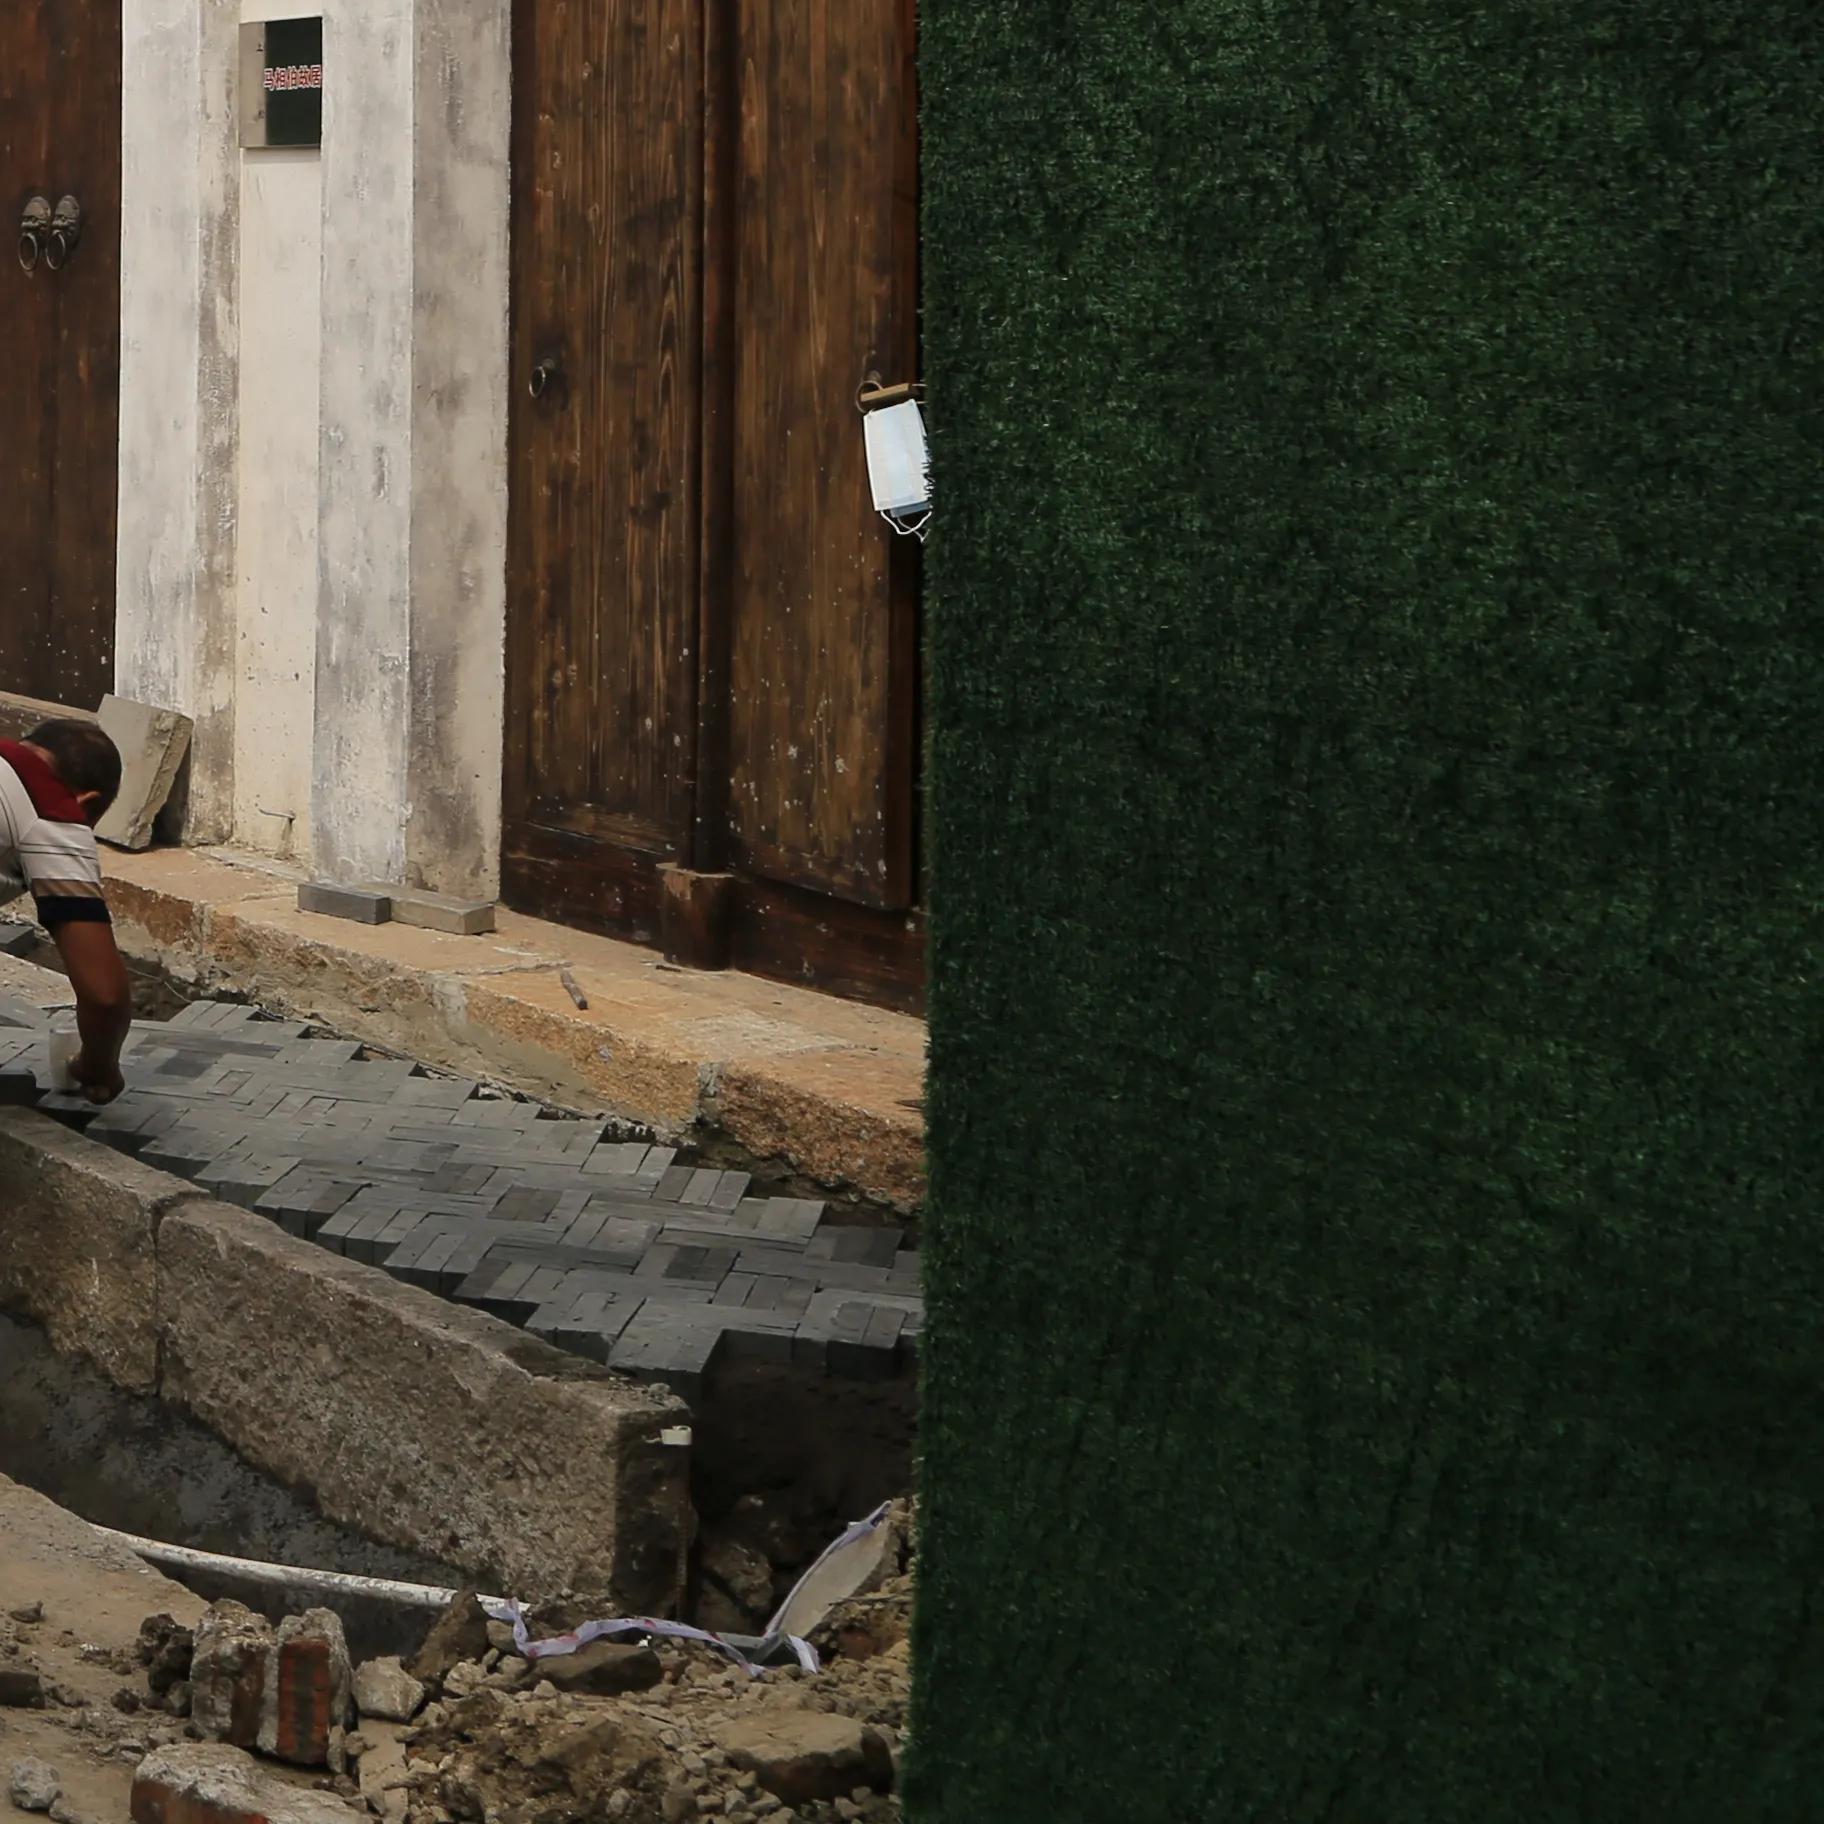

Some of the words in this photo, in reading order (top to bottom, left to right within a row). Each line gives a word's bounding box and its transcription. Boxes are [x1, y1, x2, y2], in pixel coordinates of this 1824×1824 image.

[263, 64, 322, 92] 马相伯故居
